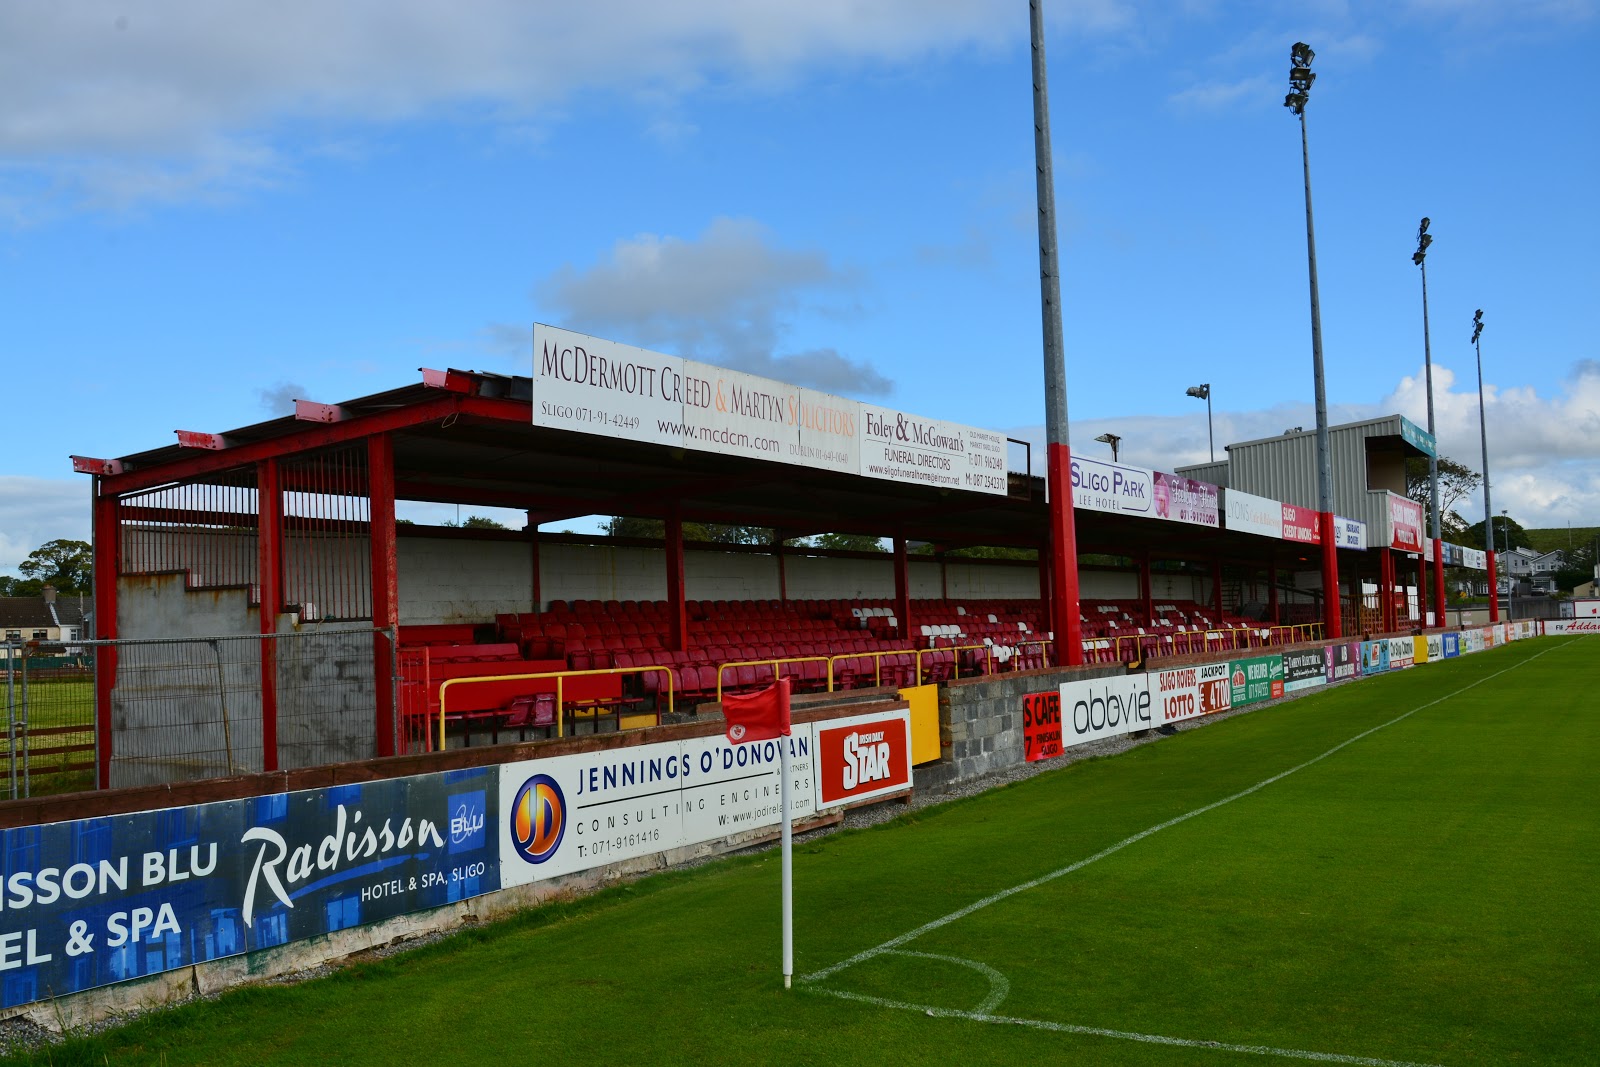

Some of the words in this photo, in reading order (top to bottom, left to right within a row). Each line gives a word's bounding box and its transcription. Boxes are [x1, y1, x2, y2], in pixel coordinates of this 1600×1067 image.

[541, 400, 573, 420] SLIGO
[575, 406, 640, 430] 071-91-42449
[660, 366, 711, 409] CREED
[715, 378, 728, 413] &
[730, 381, 784, 424] MARTYN
[787, 394, 855, 437] SOLICITORS
[657, 419, 780, 454] www.mcdcm.com
[866, 412, 894, 445] Foley
[895, 412, 910, 442] &
[912, 421, 964, 452] McGowan's
[789, 443, 815, 461] DUBLIN
[884, 448, 916, 467] FUNERAL
[917, 452, 951, 471] DIRECTORS
[1071, 462, 1109, 493] SLIGO
[1113, 470, 1145, 499] PARK
[1095, 497, 1120, 511] HOTEL
[1283, 506, 1296, 522] SLIGO
[1159, 672, 1175, 692] SLIGO
[1176, 668, 1197, 689] ROVERS
[1201, 665, 1226, 679] JACKPOT
[1073, 683, 1151, 735] abbvie
[1164, 693, 1195, 720] LOTTO
[1210, 679, 1230, 710] 4700
[1034, 695, 1060, 726] CAFE
[858, 732, 872, 745] IRISH
[871, 731, 885, 743] DAILY
[1041, 744, 1058, 756] SLIGO
[577, 753, 690, 795] JENNINGS
[842, 731, 890, 791] STAR
[576, 798, 705, 835] CONSULTING
[720, 778, 809, 806] ENGINERS
[718, 814, 730, 826] W:
[577, 845, 587, 858] T:
[592, 828, 660, 855] 071-9161416
[142, 842, 218, 887] BLU
[240, 804, 444, 928] Radisson
[361, 879, 404, 902] HOTEL
[408, 876, 417, 890] &
[421, 871, 448, 889] SPA,
[452, 861, 485, 882] SLIGO
[65, 919, 95, 957] &
[107, 902, 181, 947] SPA
